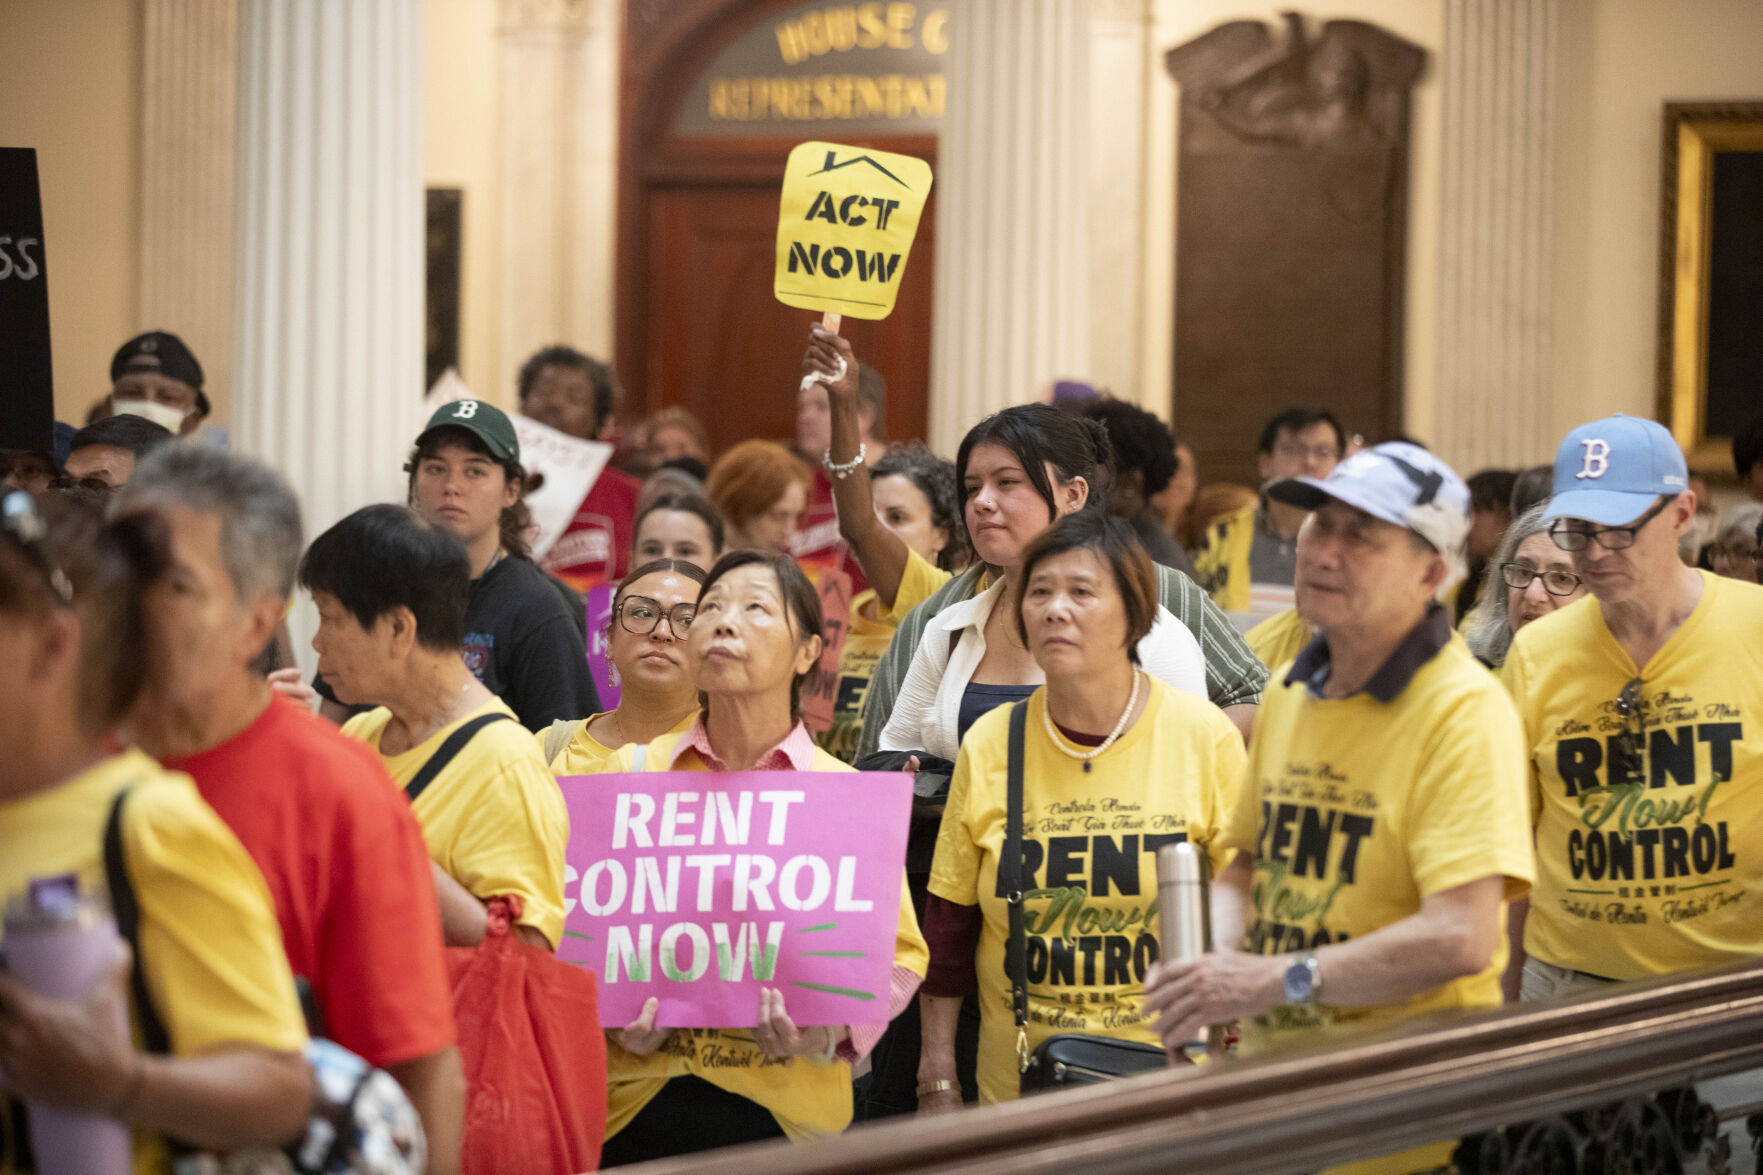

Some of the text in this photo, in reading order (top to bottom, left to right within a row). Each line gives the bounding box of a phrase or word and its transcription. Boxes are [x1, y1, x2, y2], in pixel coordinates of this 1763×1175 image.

[775, 2, 916, 65] HOUSE
[805, 190, 900, 231] ACT
[787, 241, 902, 283] NOW
[452, 400, 478, 419] B
[1575, 438, 1611, 480] B
[1557, 722, 1743, 797] RENT
[612, 790, 806, 850] RENT
[1577, 771, 1722, 840] Now!
[1568, 821, 1736, 881] CONTROL
[604, 921, 786, 984] NOW
[1003, 932, 1161, 987] ONTRO
